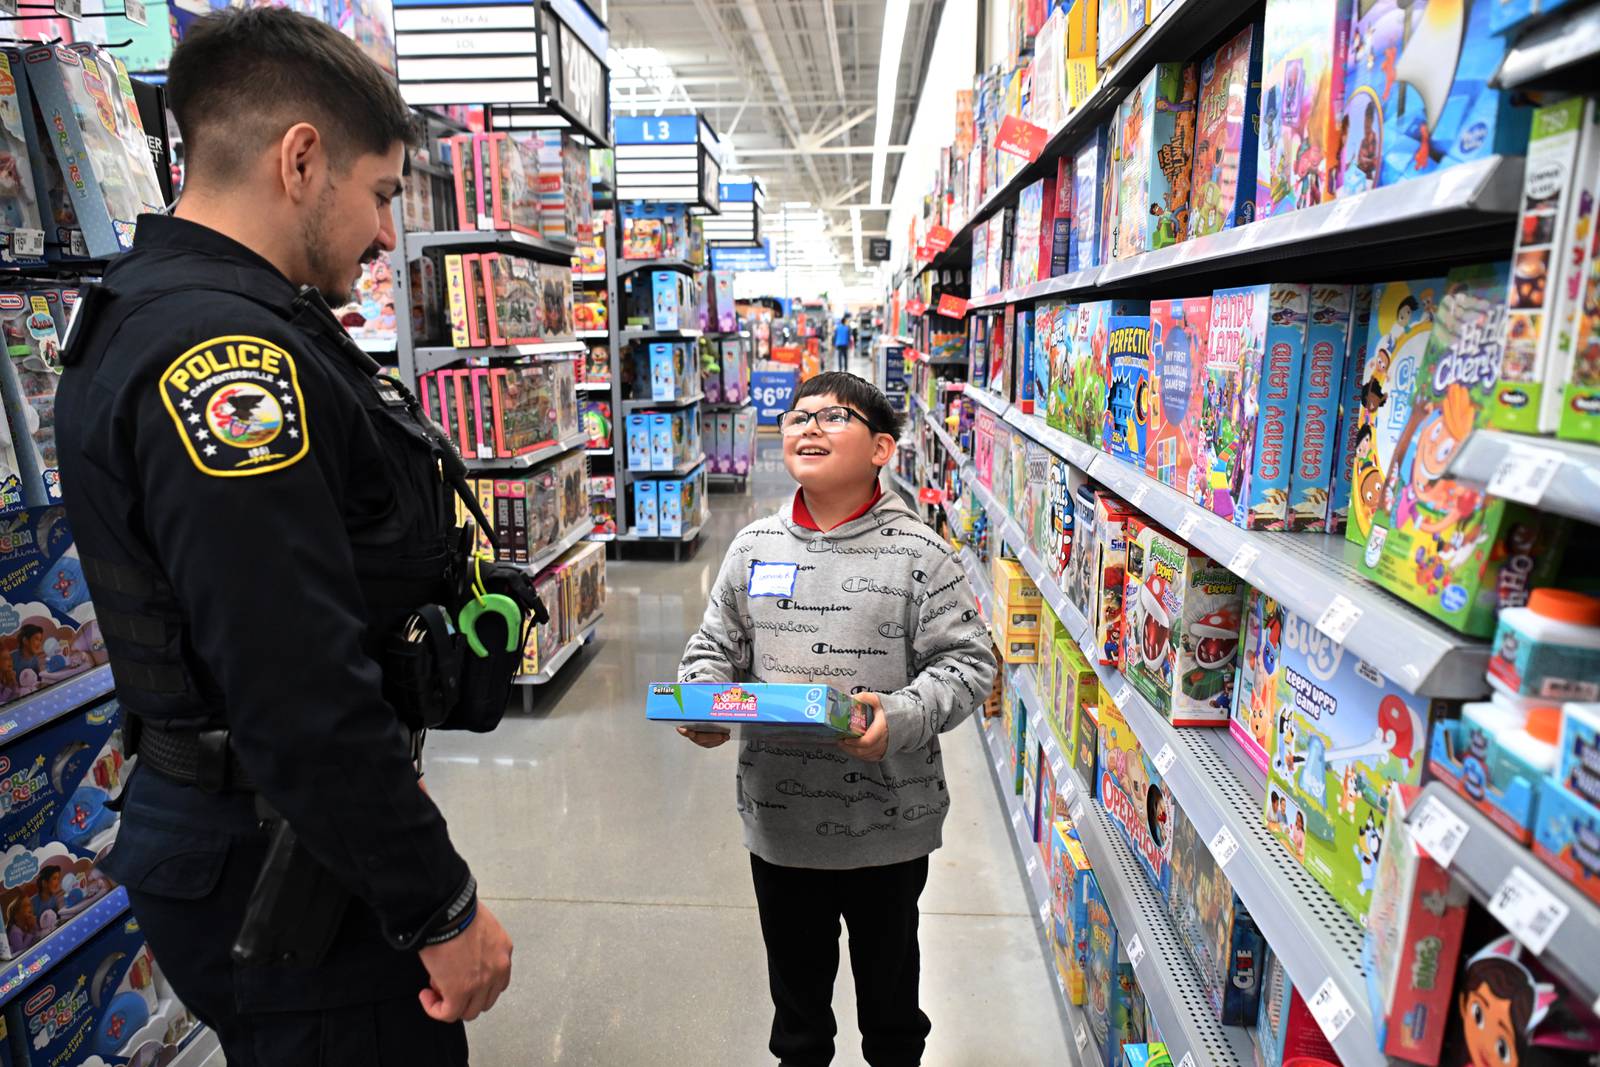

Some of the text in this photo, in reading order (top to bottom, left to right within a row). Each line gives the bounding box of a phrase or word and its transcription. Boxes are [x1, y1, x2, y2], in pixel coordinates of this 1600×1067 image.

[642, 121, 671, 140] L 3
[1212, 292, 1256, 328] CANDY
[1209, 331, 1238, 363] LAND
[169, 344, 282, 392] POLICE
[1259, 342, 1293, 481] CANDY LAND
[1301, 341, 1335, 481] CANDY LAND
[806, 538, 922, 560] Champion
[776, 598, 852, 615] Champion
[811, 642, 888, 659] Champion
[762, 653, 857, 681] Champion
[712, 702, 757, 710] ADOPT ME!
[1101, 772, 1163, 881] OPERATION
[1232, 949, 1255, 990] CLUE
